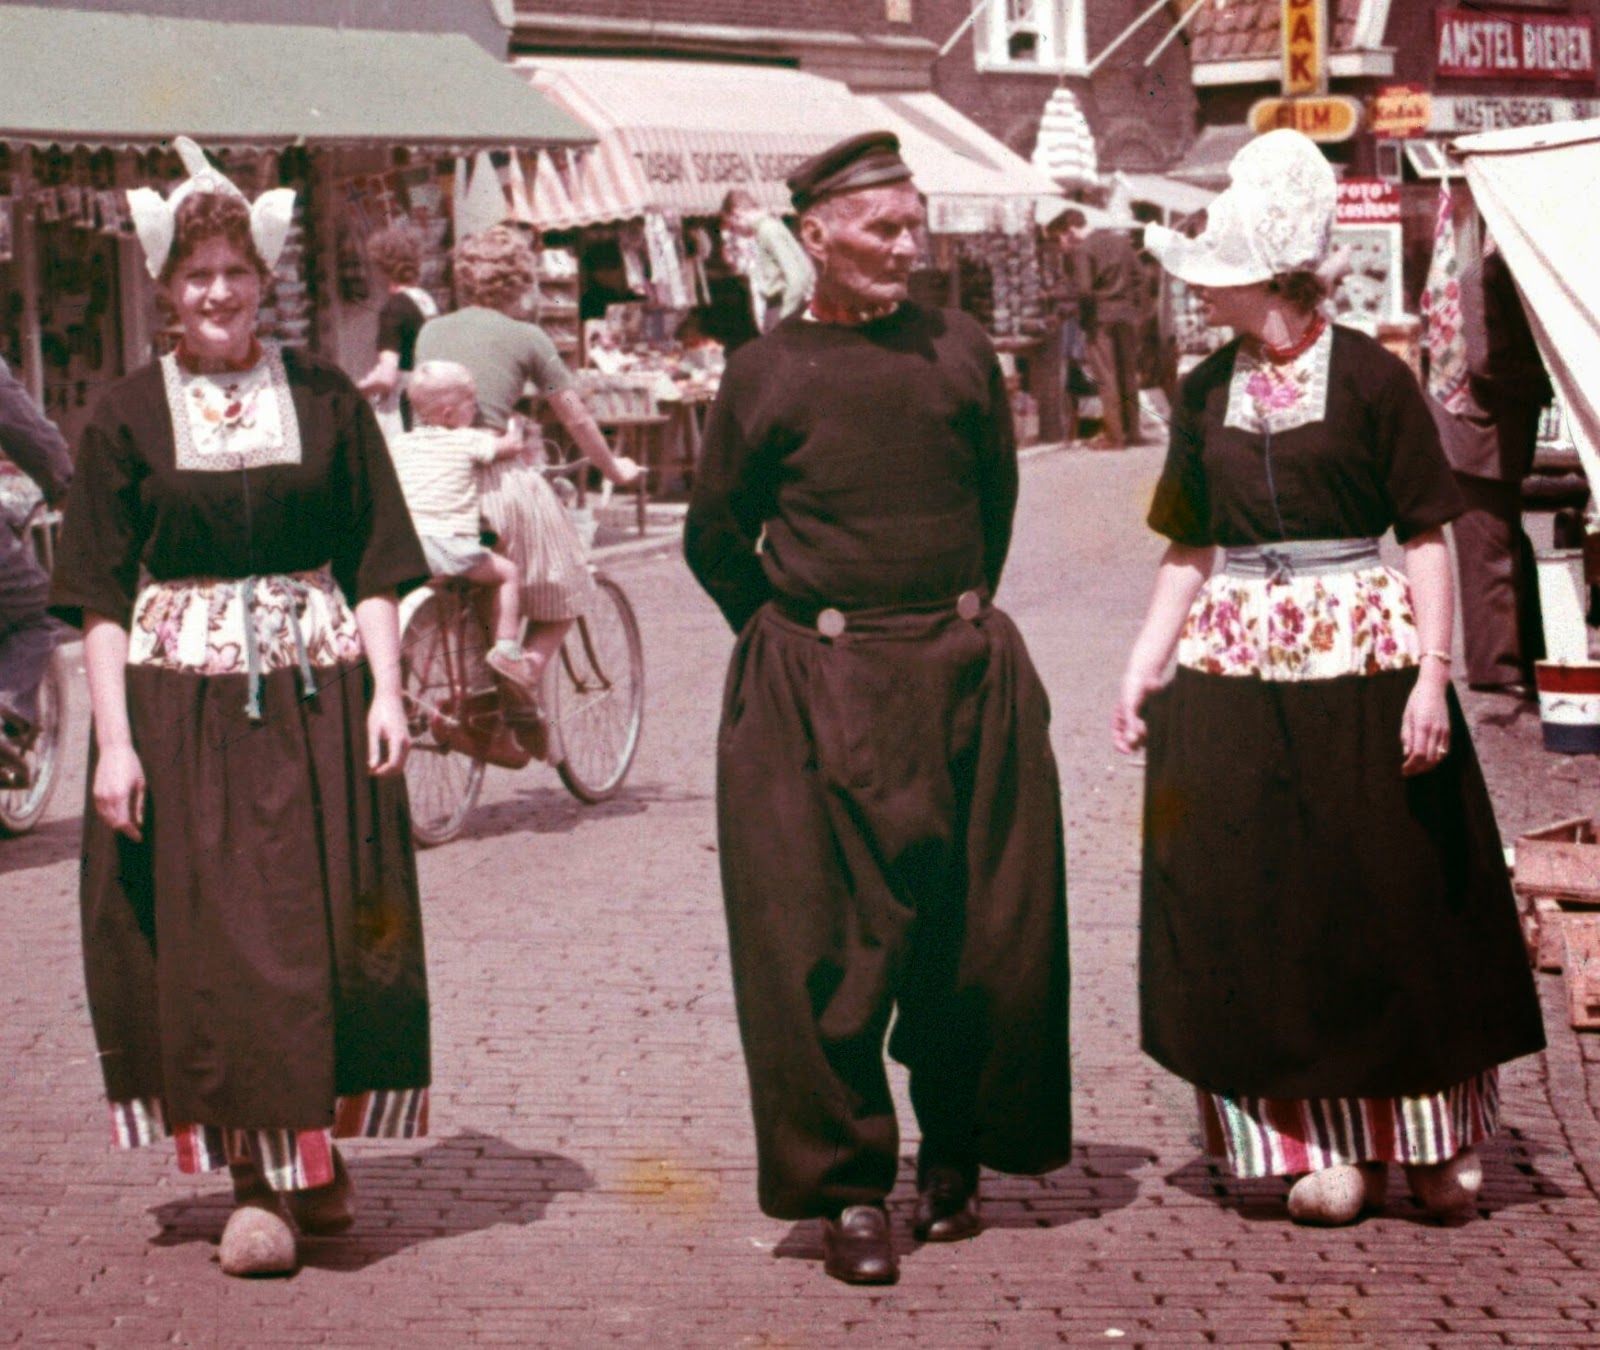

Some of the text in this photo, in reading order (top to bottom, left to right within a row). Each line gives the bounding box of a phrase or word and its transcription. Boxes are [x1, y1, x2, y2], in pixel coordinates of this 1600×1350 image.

[1439, 20, 1592, 70] AMSTEL BIEREN
[1275, 104, 1331, 130] FILM
